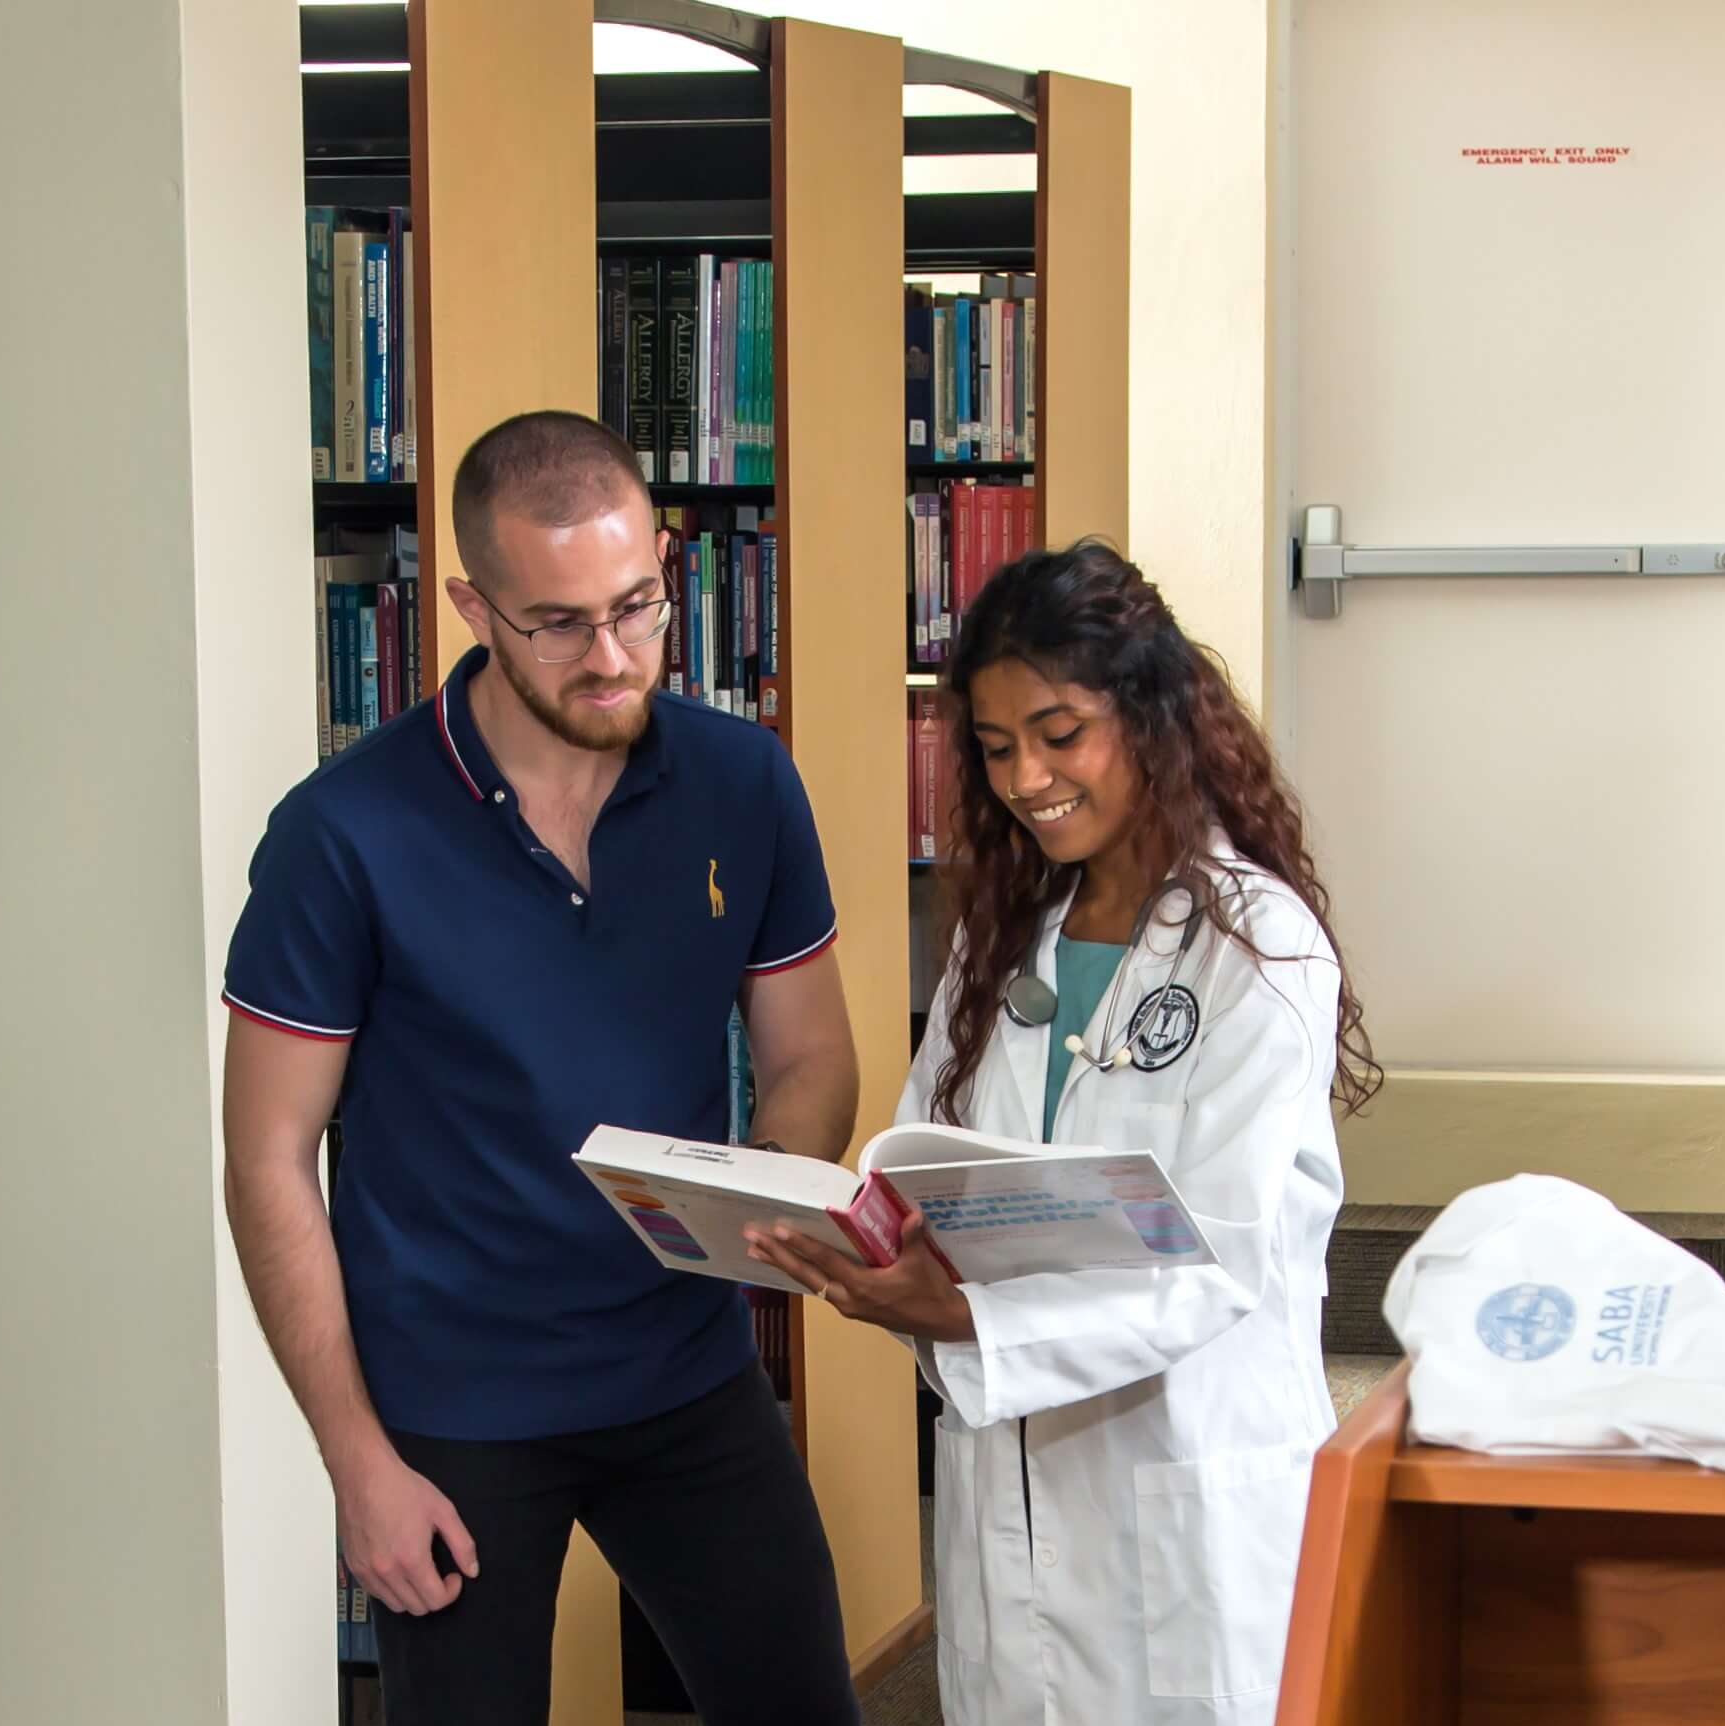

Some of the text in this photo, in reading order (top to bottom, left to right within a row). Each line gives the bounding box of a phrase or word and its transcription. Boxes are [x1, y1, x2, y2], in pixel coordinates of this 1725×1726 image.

[1462, 147, 1630, 156] EMERGENCY EXIT ONLY
[1477, 156, 1616, 165] ALARM WILL SOUND
[612, 288, 626, 345] ALLERGY
[637, 314, 655, 402] ALLERGY
[676, 312, 694, 403] ALLERGY
[670, 605, 680, 665] ORTHOPAEDICS
[928, 1198, 1116, 1221] Molecular
[935, 1211, 1099, 1231] Genetics
[1592, 1284, 1640, 1365] SABA
[1629, 1284, 1659, 1366] UNIVERSITY
